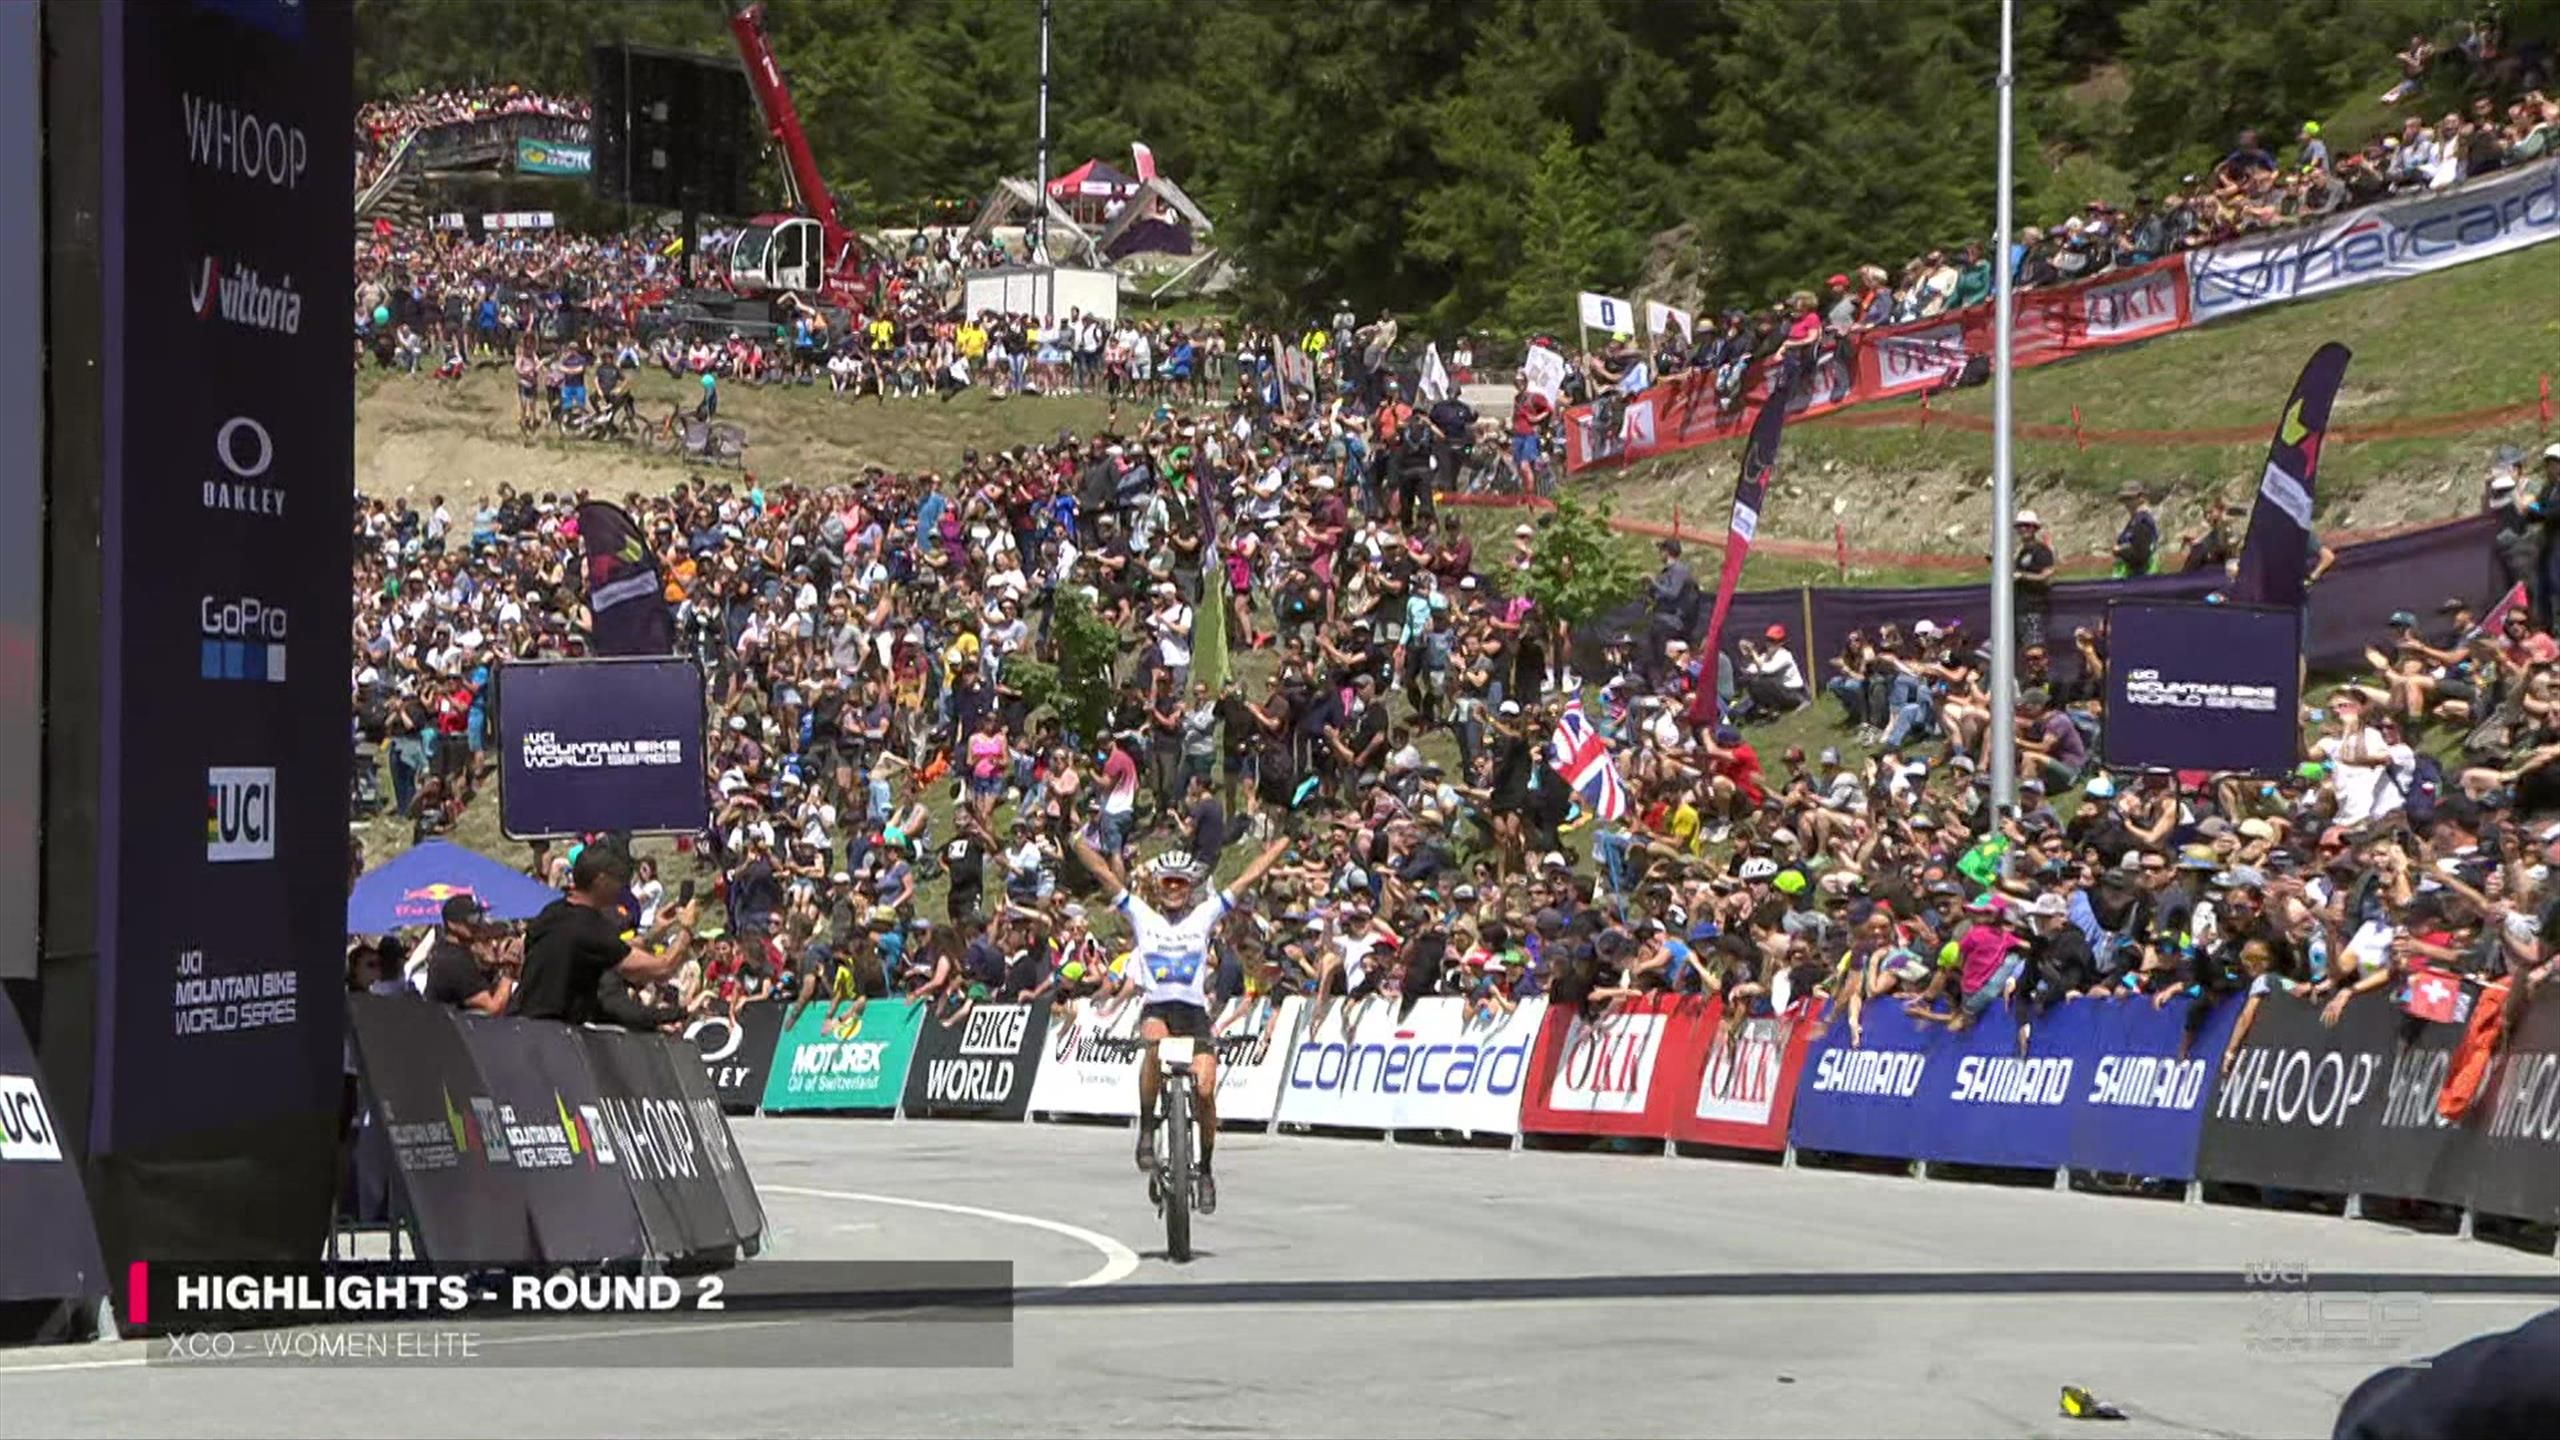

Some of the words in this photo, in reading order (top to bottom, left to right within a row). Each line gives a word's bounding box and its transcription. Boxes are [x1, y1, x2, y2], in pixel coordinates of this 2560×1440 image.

[183, 91, 307, 189] WHOOP
[219, 262, 301, 334] vittoria
[203, 481, 286, 516] OAKLEY
[202, 596, 287, 638] GoPro
[523, 742, 630, 756] MOUNTAIN
[529, 732, 555, 744] UCI
[524, 753, 602, 768] WORLD
[220, 783, 270, 843] UCI
[181, 950, 202, 975] UCI
[176, 974, 259, 1006] MOUNTAIN
[262, 971, 297, 997] BIKE
[176, 1006, 239, 1035] WORLD
[240, 998, 297, 1028] SERIES
[965, 1011, 1026, 1049] BIKE
[819, 1074, 880, 1091] Switzerland
[927, 1059, 1014, 1101] WORLD
[1813, 1048, 1925, 1097] SHIMANO
[1951, 1056, 2073, 1104] SHIMANO
[2088, 1055, 2206, 1110] SHIMANO
[2216, 1049, 2373, 1128] WHOOP
[0, 1091, 51, 1146] UCI
[600, 1096, 698, 1181] WHOOP
